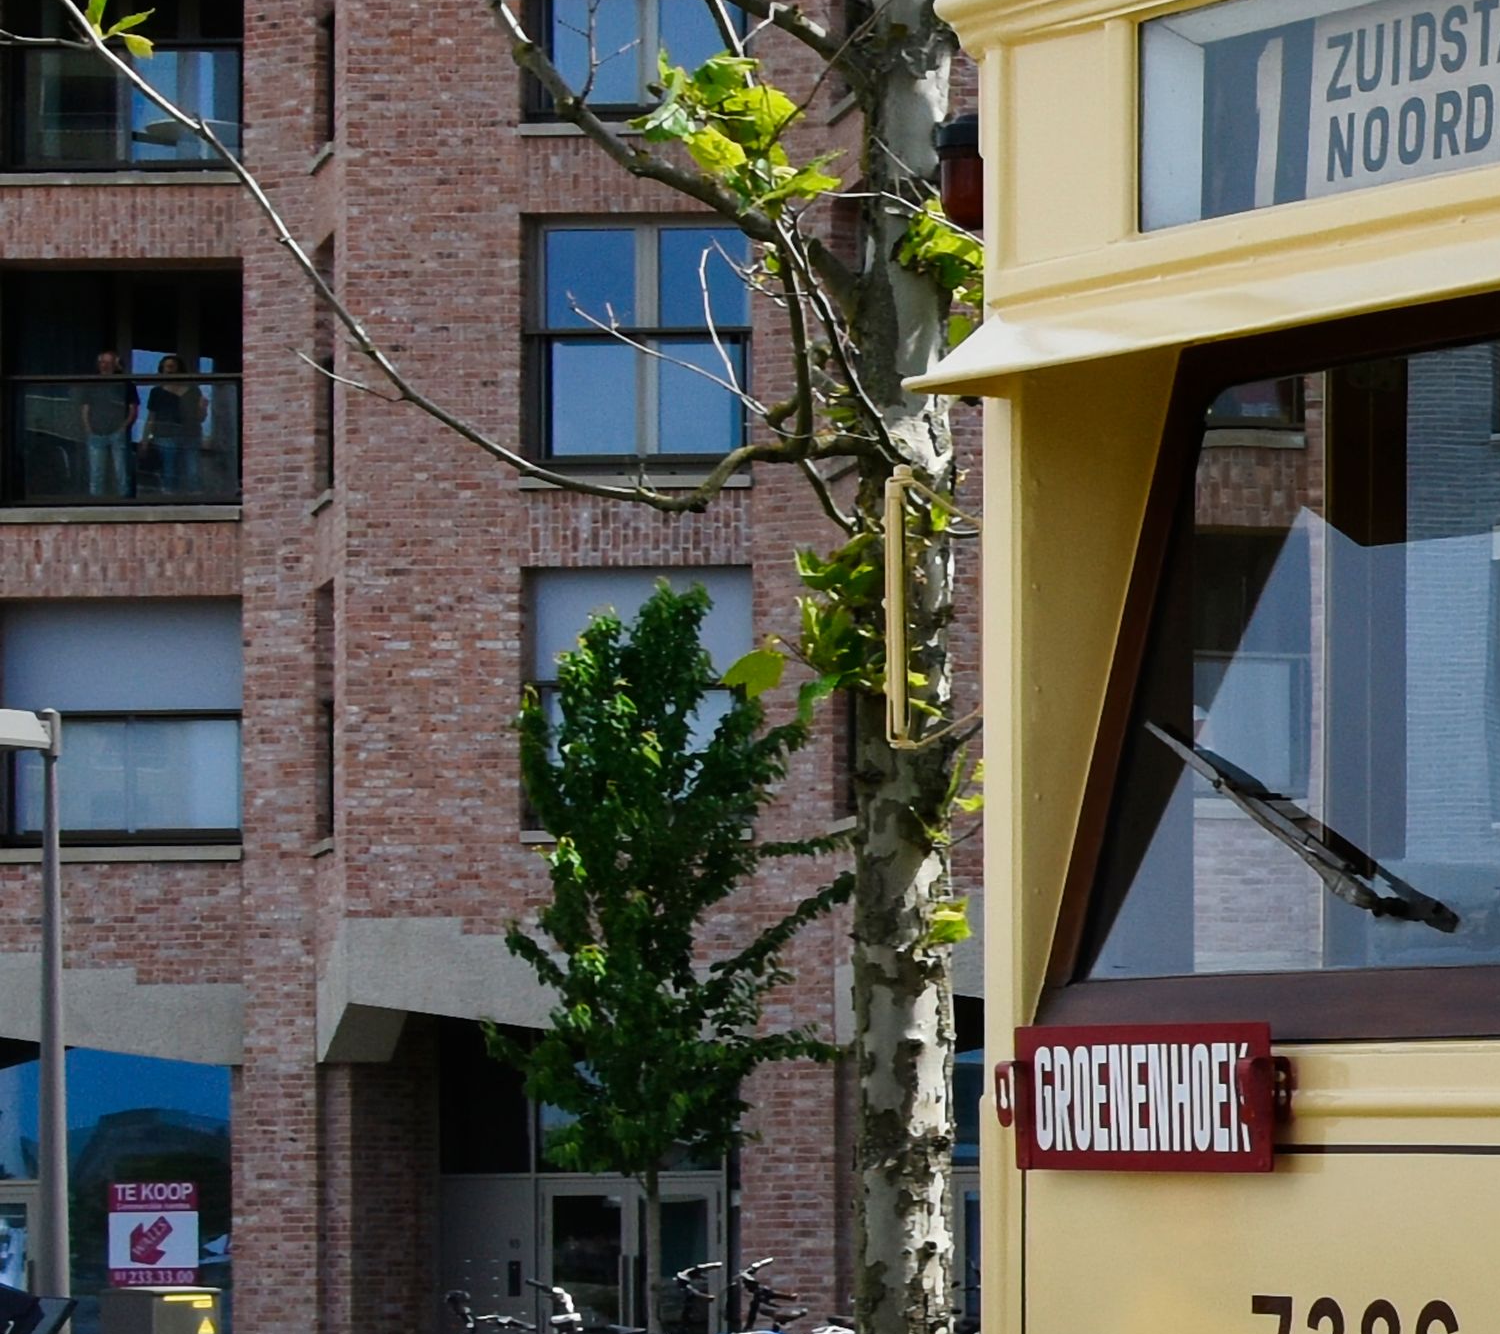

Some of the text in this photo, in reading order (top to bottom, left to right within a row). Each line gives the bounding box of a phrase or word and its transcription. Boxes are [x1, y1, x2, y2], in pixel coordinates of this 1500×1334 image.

[1254, 36, 1284, 207] 1
[1034, 1042, 1251, 1153] GROENENHOEK
[114, 1182, 193, 1201] TE KOOP
